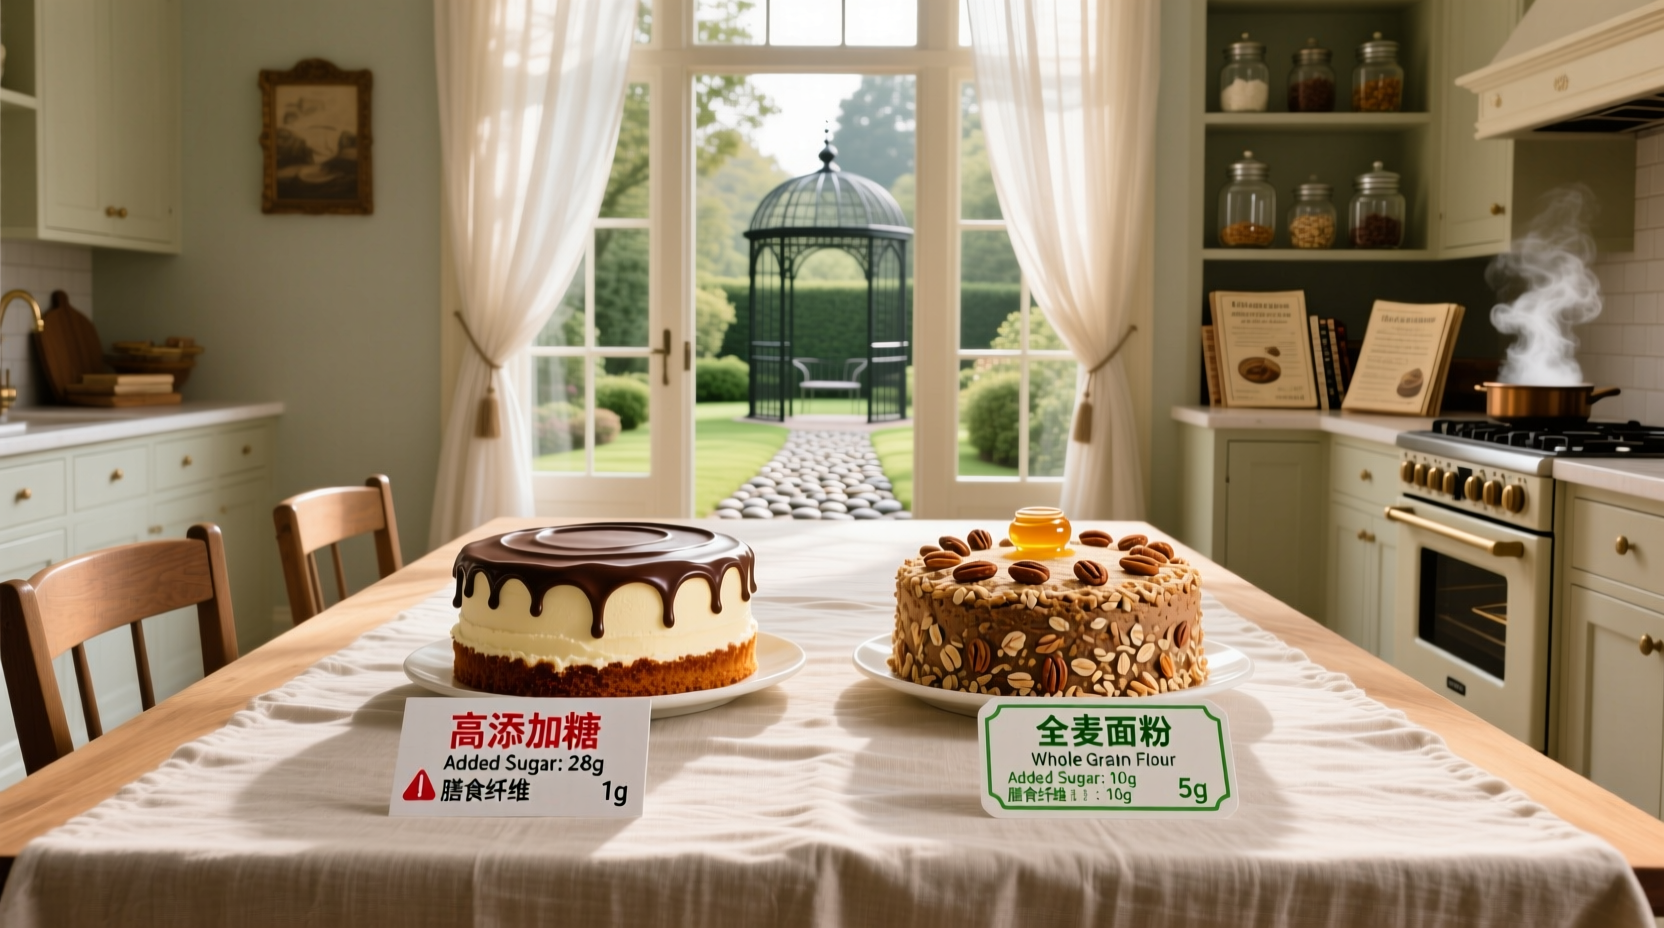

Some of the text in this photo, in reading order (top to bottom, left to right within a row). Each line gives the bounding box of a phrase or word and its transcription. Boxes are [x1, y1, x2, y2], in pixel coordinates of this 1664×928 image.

[451, 711, 601, 750] 高添加糖
[1036, 714, 1172, 748] 全麦面粉
[443, 754, 604, 776] Added Sugar: 28g
[1032, 752, 1176, 767] Whole Grain Flour
[1008, 771, 1137, 787] Added Sugar: 10g
[1178, 777, 1208, 804] 5g
[441, 778, 628, 807] 膳食纤维 1g
[1106, 788, 1132, 804] 10g
